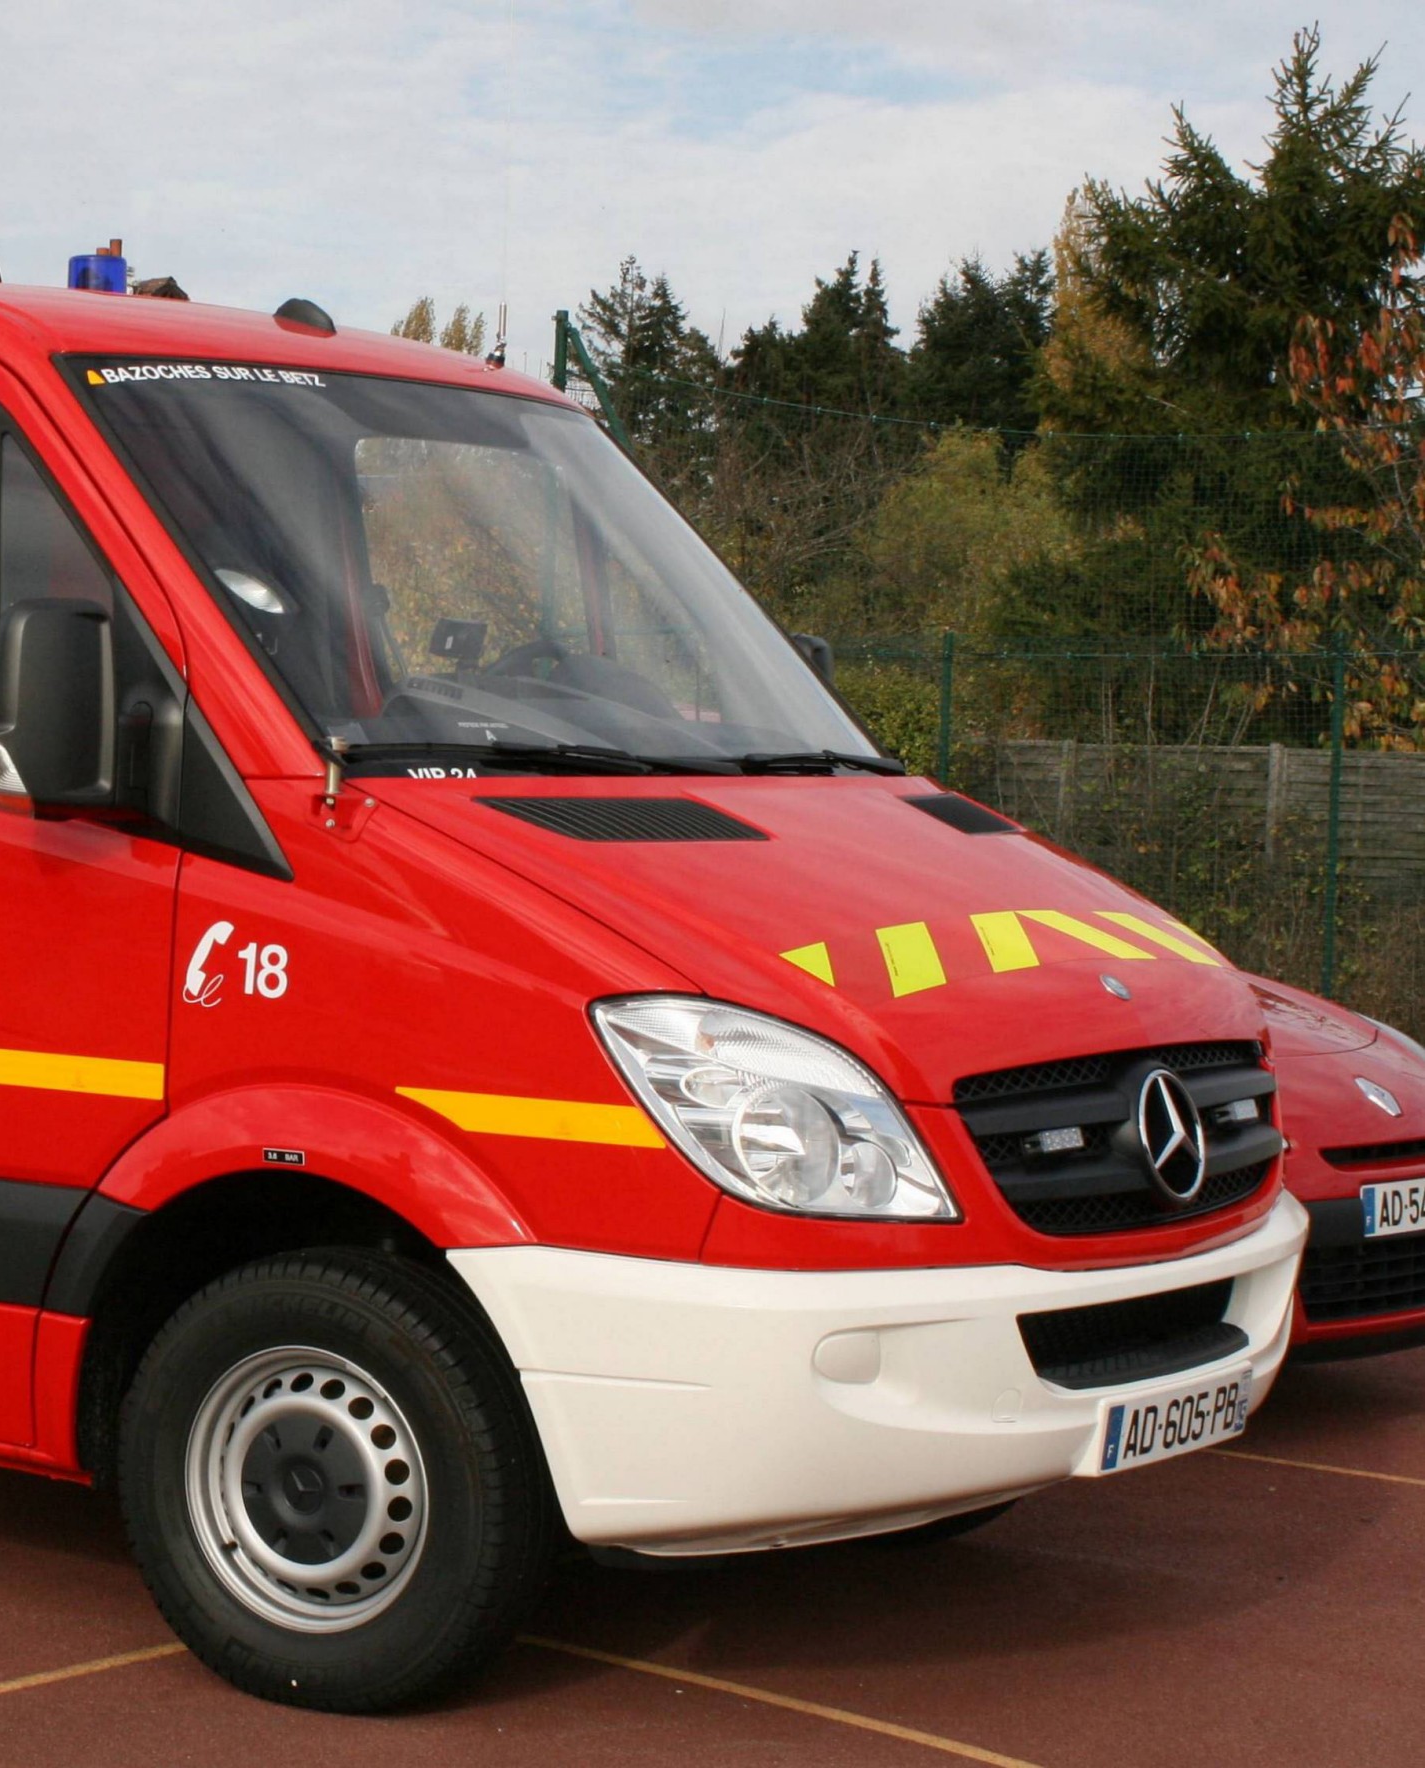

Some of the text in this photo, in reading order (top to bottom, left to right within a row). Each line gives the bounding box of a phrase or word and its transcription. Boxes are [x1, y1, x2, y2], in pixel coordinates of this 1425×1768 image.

[101, 366, 326, 387] BAZOCHES SUR LE BETZ
[238, 942, 288, 999] 18
